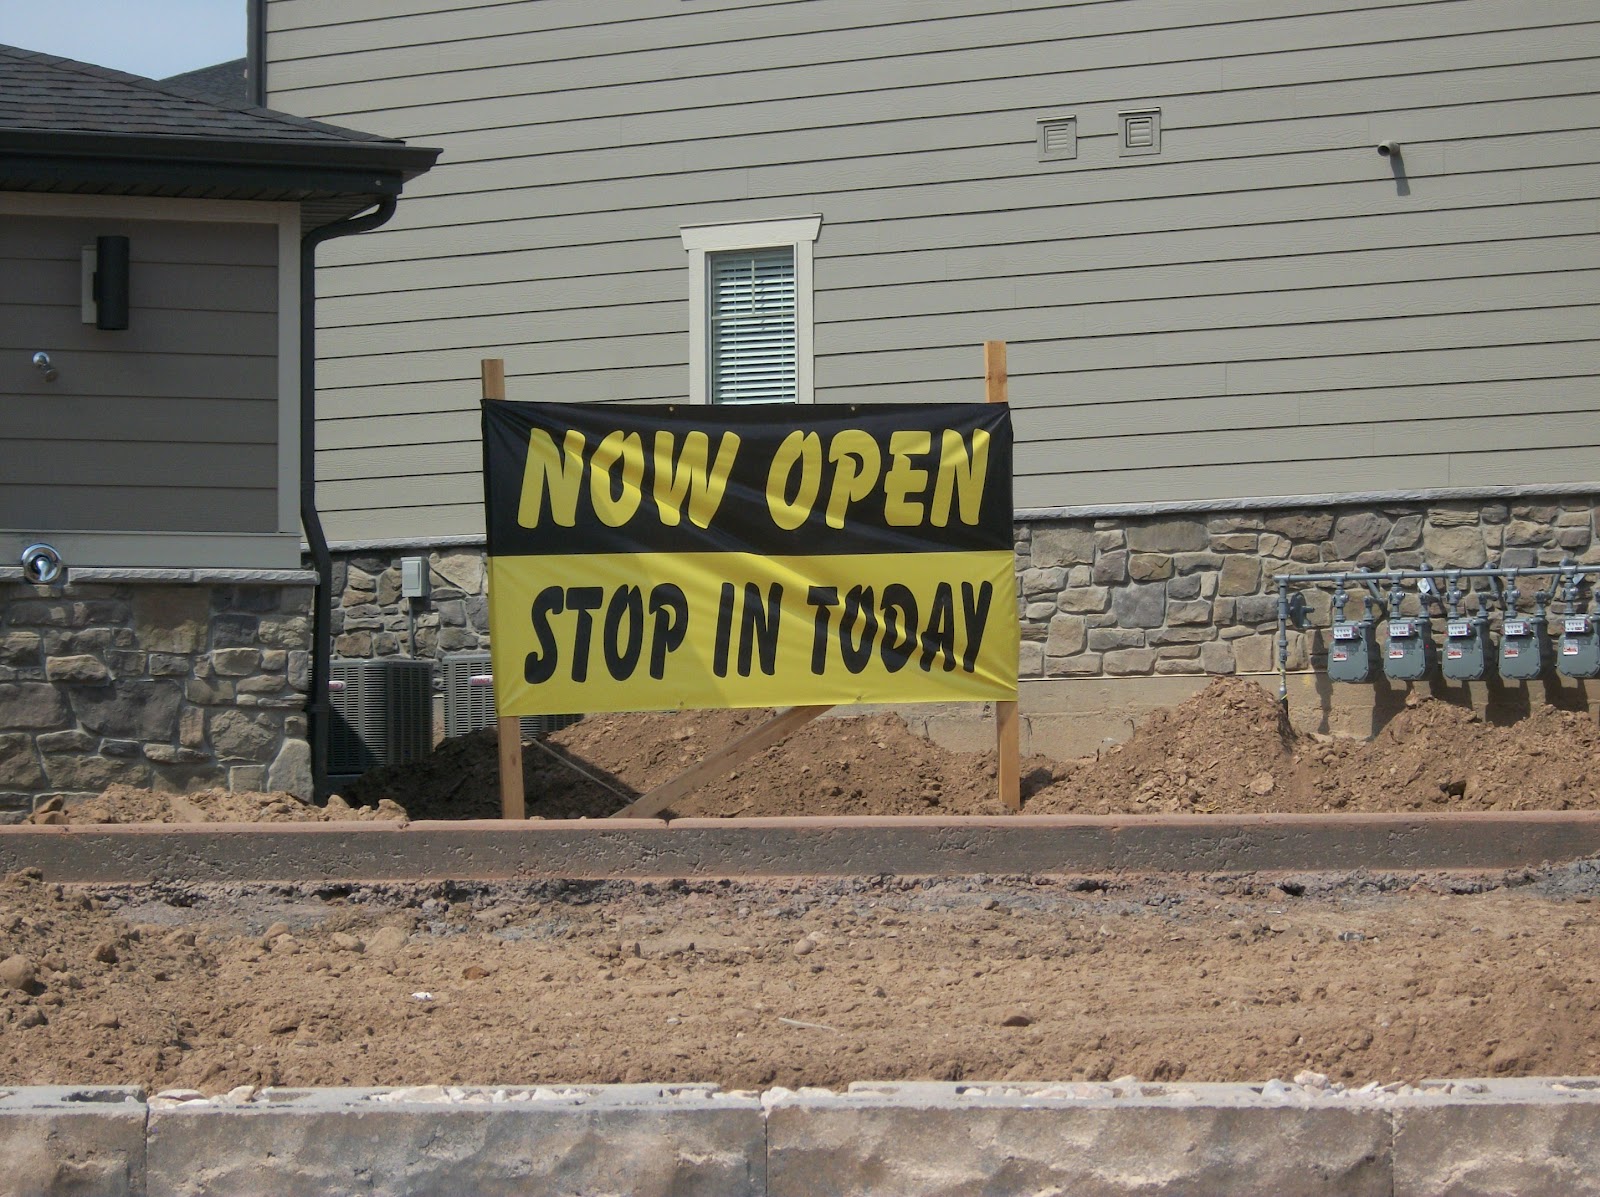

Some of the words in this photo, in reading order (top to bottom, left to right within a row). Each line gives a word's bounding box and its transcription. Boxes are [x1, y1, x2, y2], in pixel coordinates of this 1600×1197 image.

[517, 428, 741, 530] NOW
[765, 429, 991, 531] OPEN
[524, 582, 689, 684] STOP
[713, 581, 783, 678] IN
[807, 581, 993, 676] TODAY
